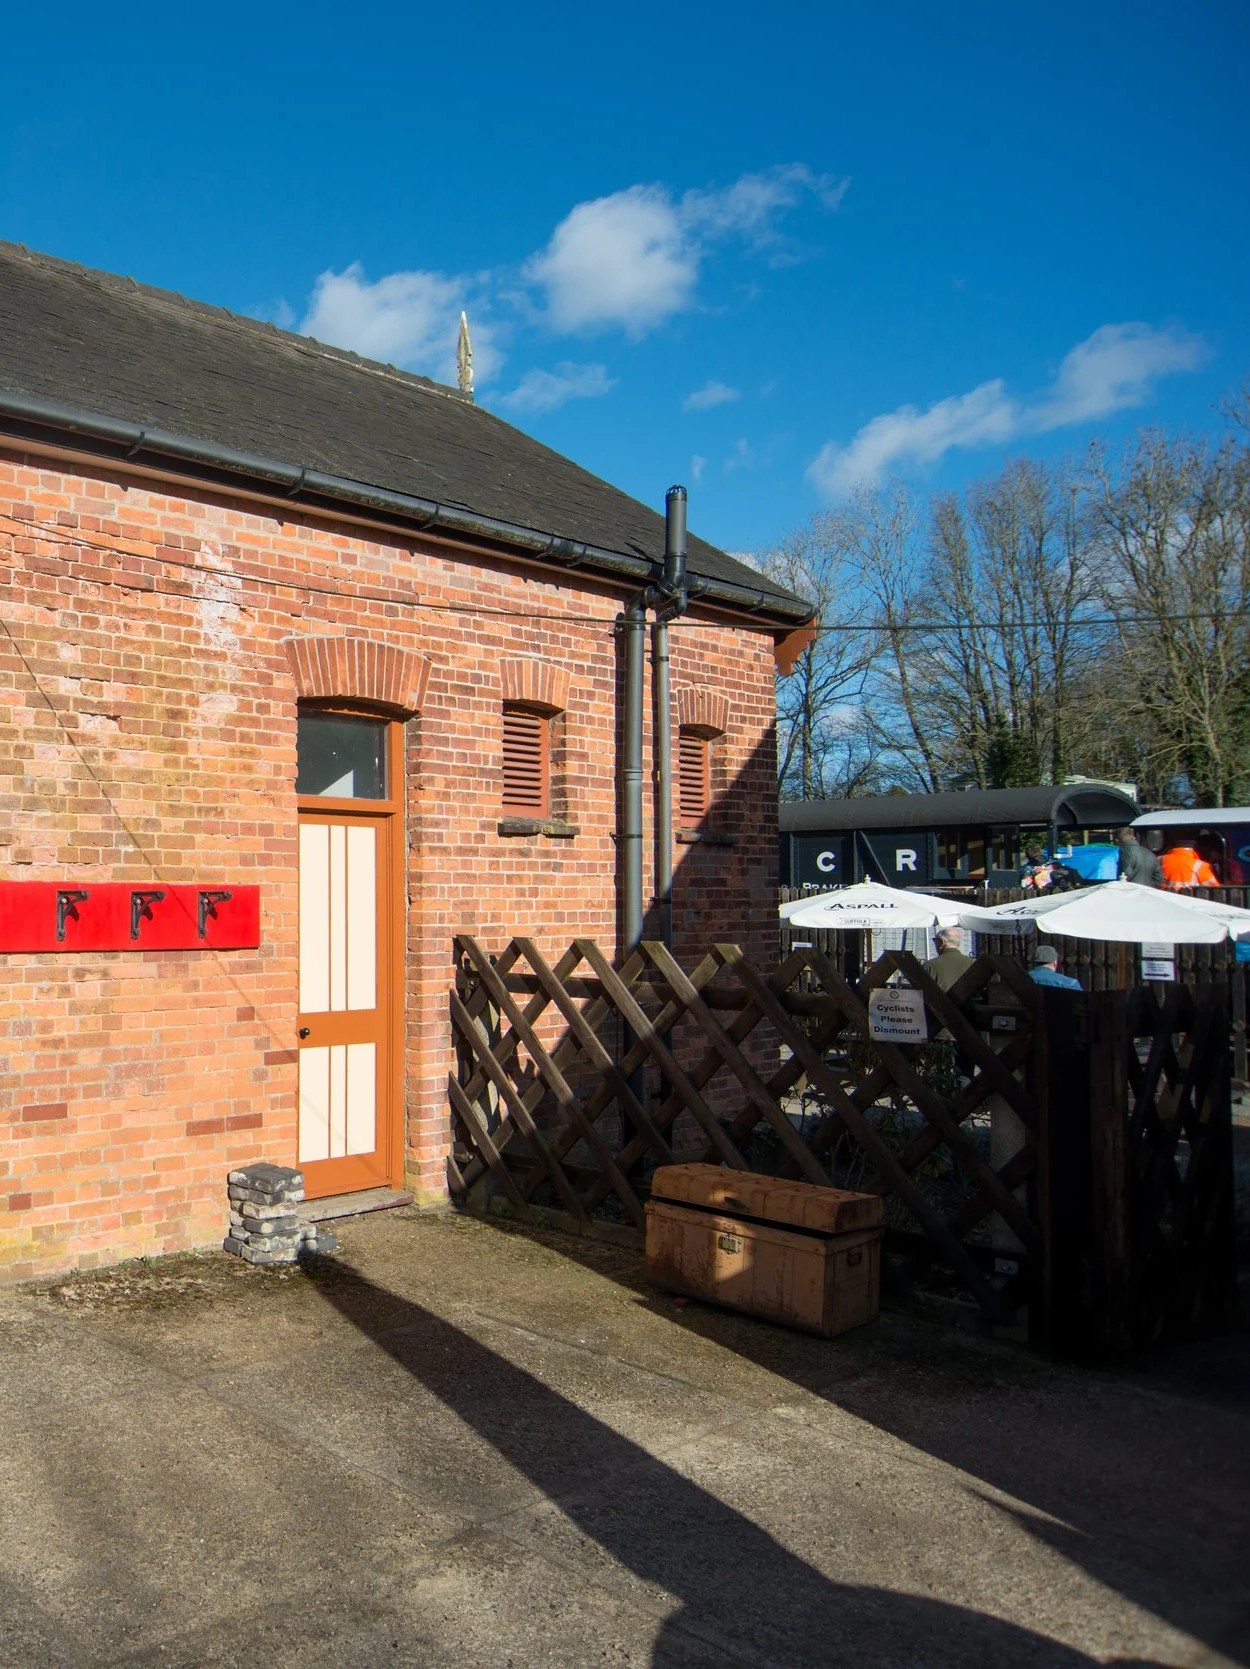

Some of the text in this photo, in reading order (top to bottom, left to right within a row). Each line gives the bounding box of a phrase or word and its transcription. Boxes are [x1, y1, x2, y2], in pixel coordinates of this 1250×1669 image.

[816, 848, 918, 872] C R
[824, 902, 899, 912] ASPALL
[877, 1004, 915, 1013] Cyclists
[880, 1015, 913, 1024] Please
[874, 1026, 920, 1035] Dismount
